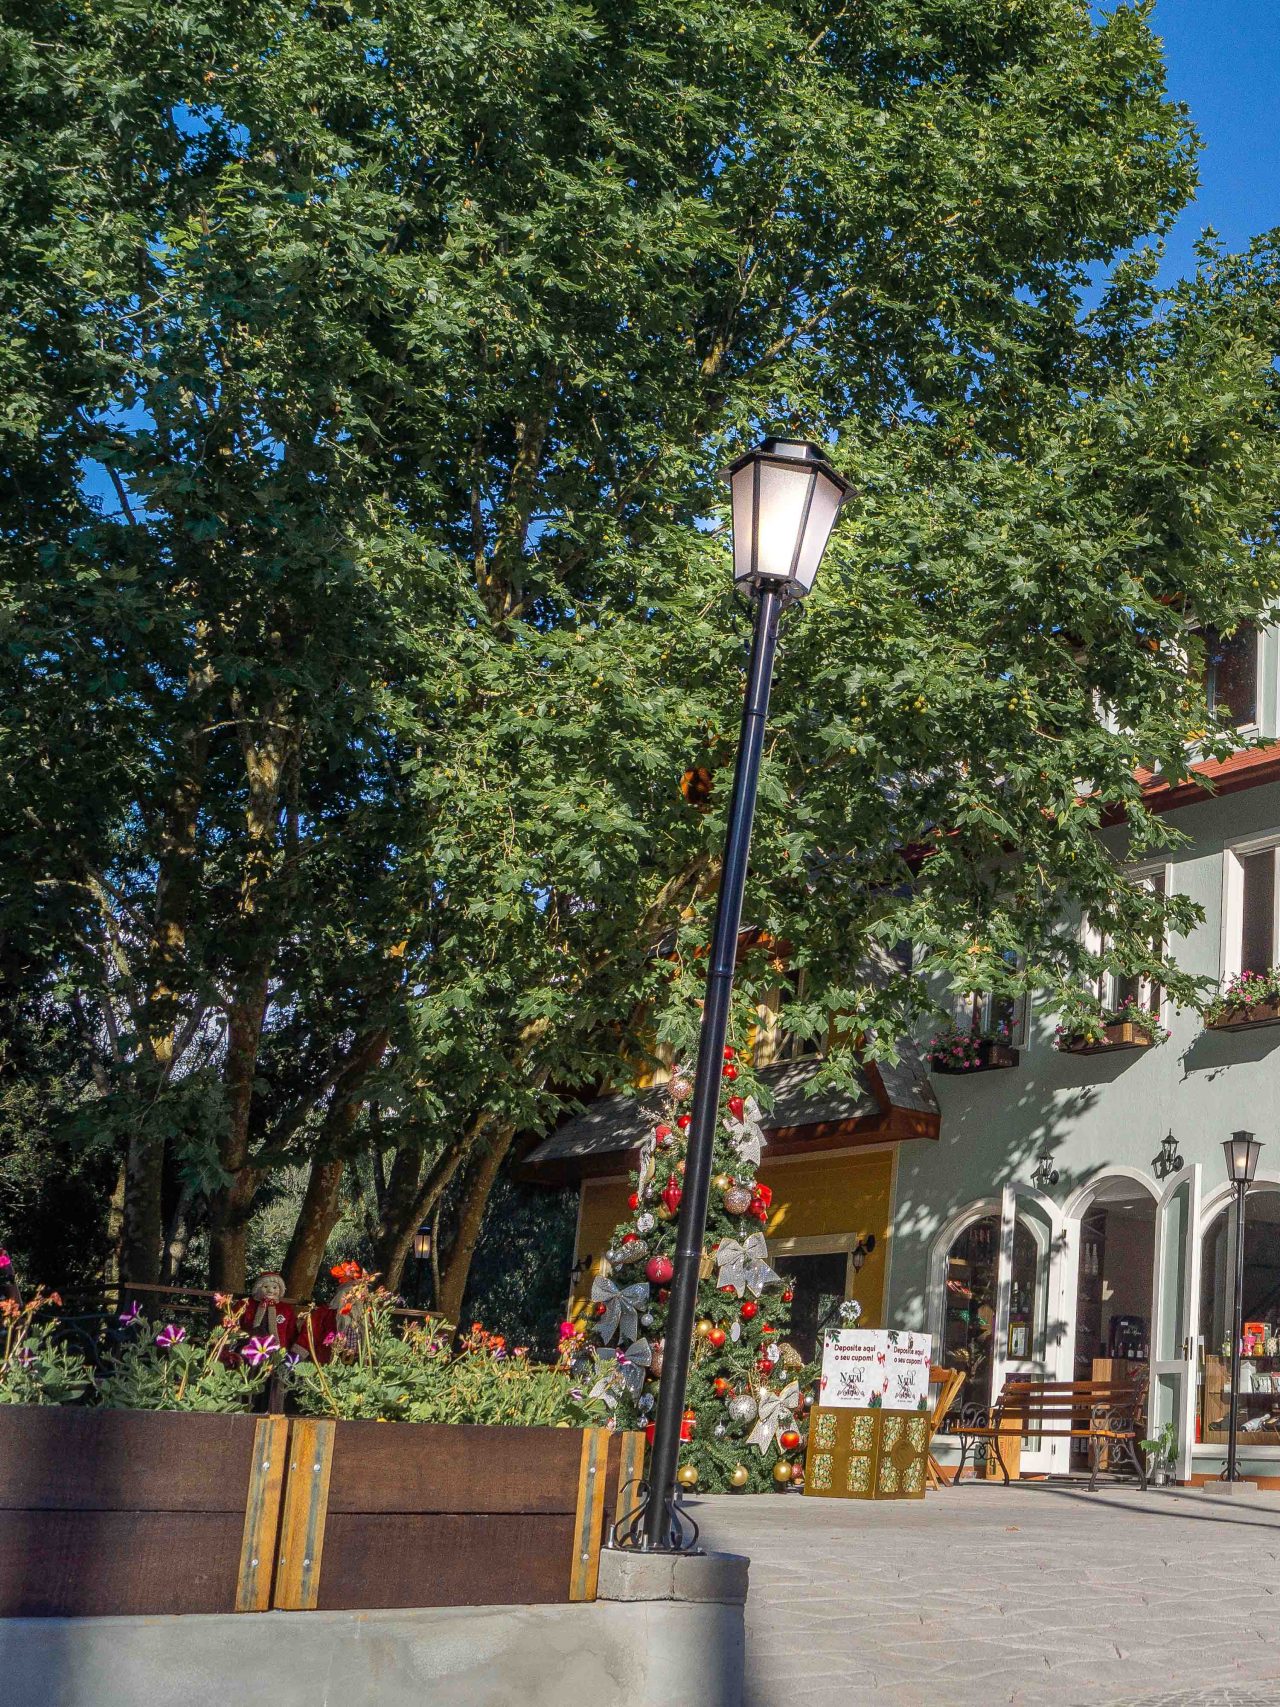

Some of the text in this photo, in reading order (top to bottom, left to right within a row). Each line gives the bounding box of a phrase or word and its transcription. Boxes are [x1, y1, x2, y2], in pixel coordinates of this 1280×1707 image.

[834, 1344, 876, 1353] Deposite aqui
[894, 1346, 914, 1355] Deposite
